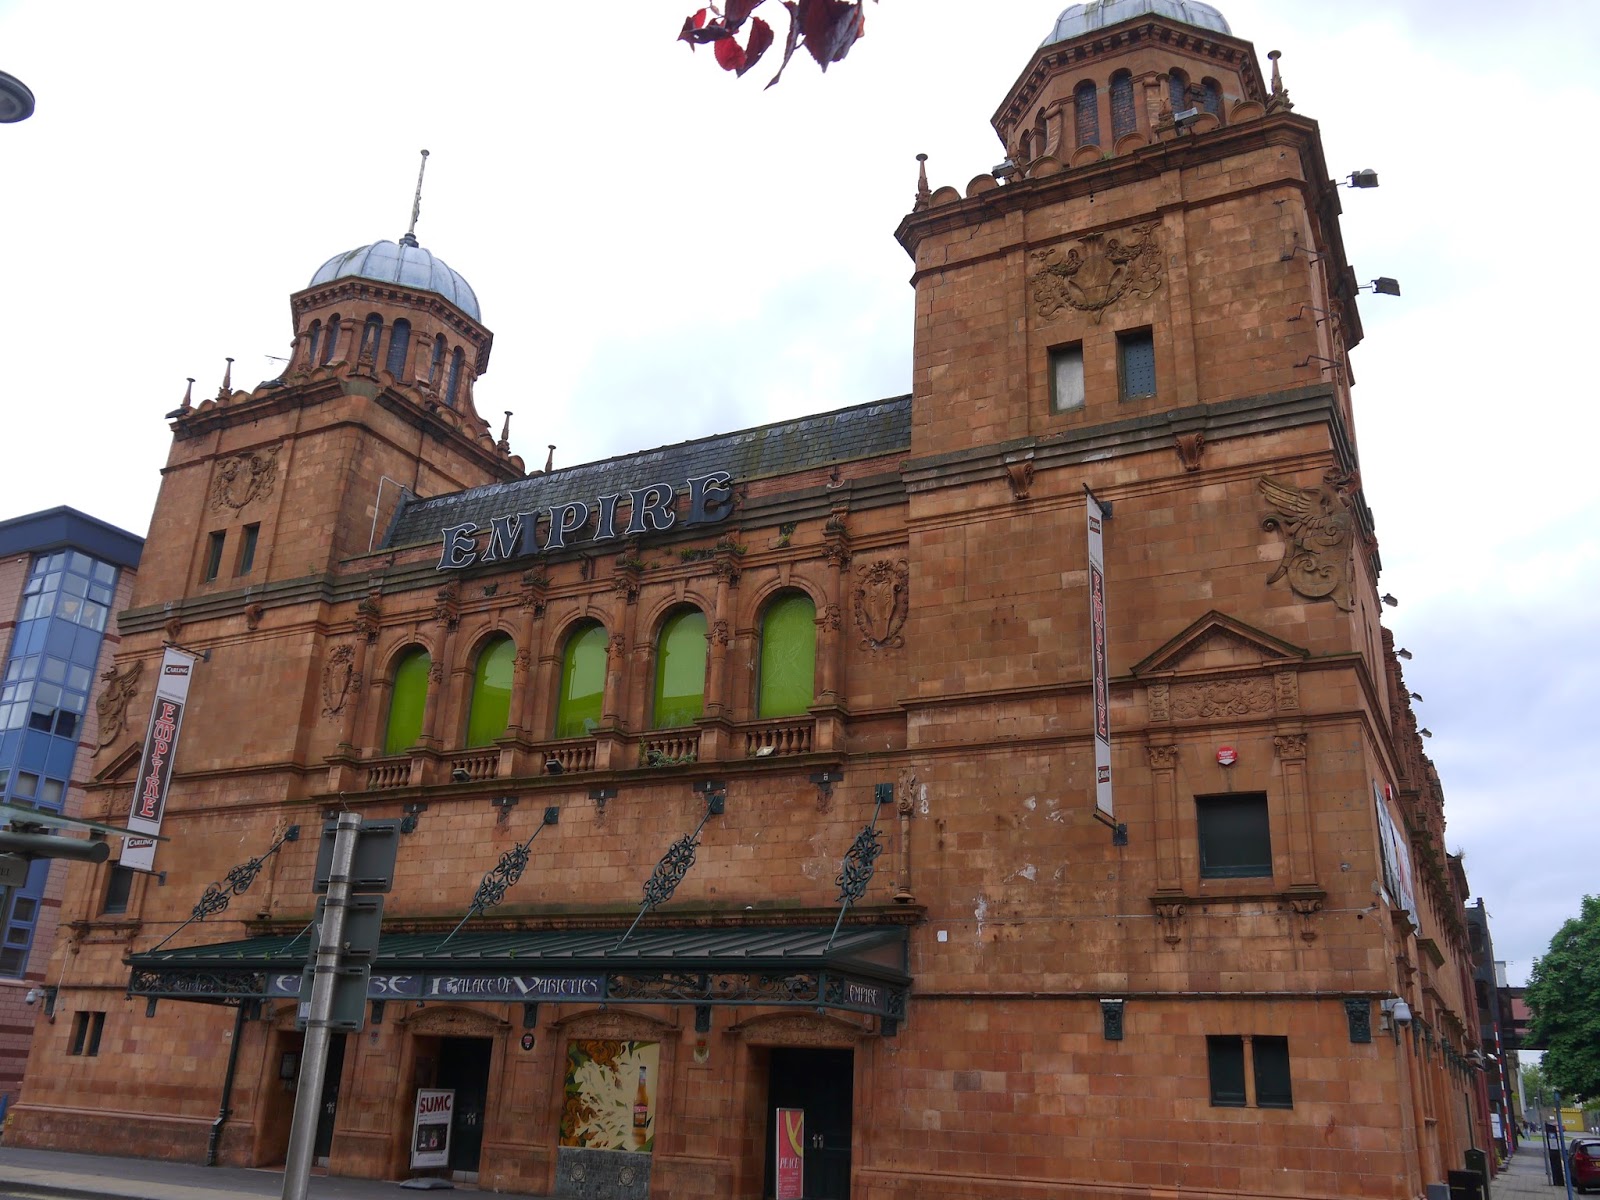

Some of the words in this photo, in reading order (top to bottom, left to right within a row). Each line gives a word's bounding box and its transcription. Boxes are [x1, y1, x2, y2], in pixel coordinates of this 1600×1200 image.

[436, 471, 735, 571] EMPIRE
[165, 666, 188, 674] CARLING
[140, 702, 177, 818] EMPIRE
[129, 838, 153, 847] CARLING
[430, 976, 495, 995] PALACE
[497, 977, 514, 994] OF
[513, 976, 598, 998] VARIETIES
[849, 984, 878, 1006] EMPIRE
[419, 1094, 452, 1114] SUMC
